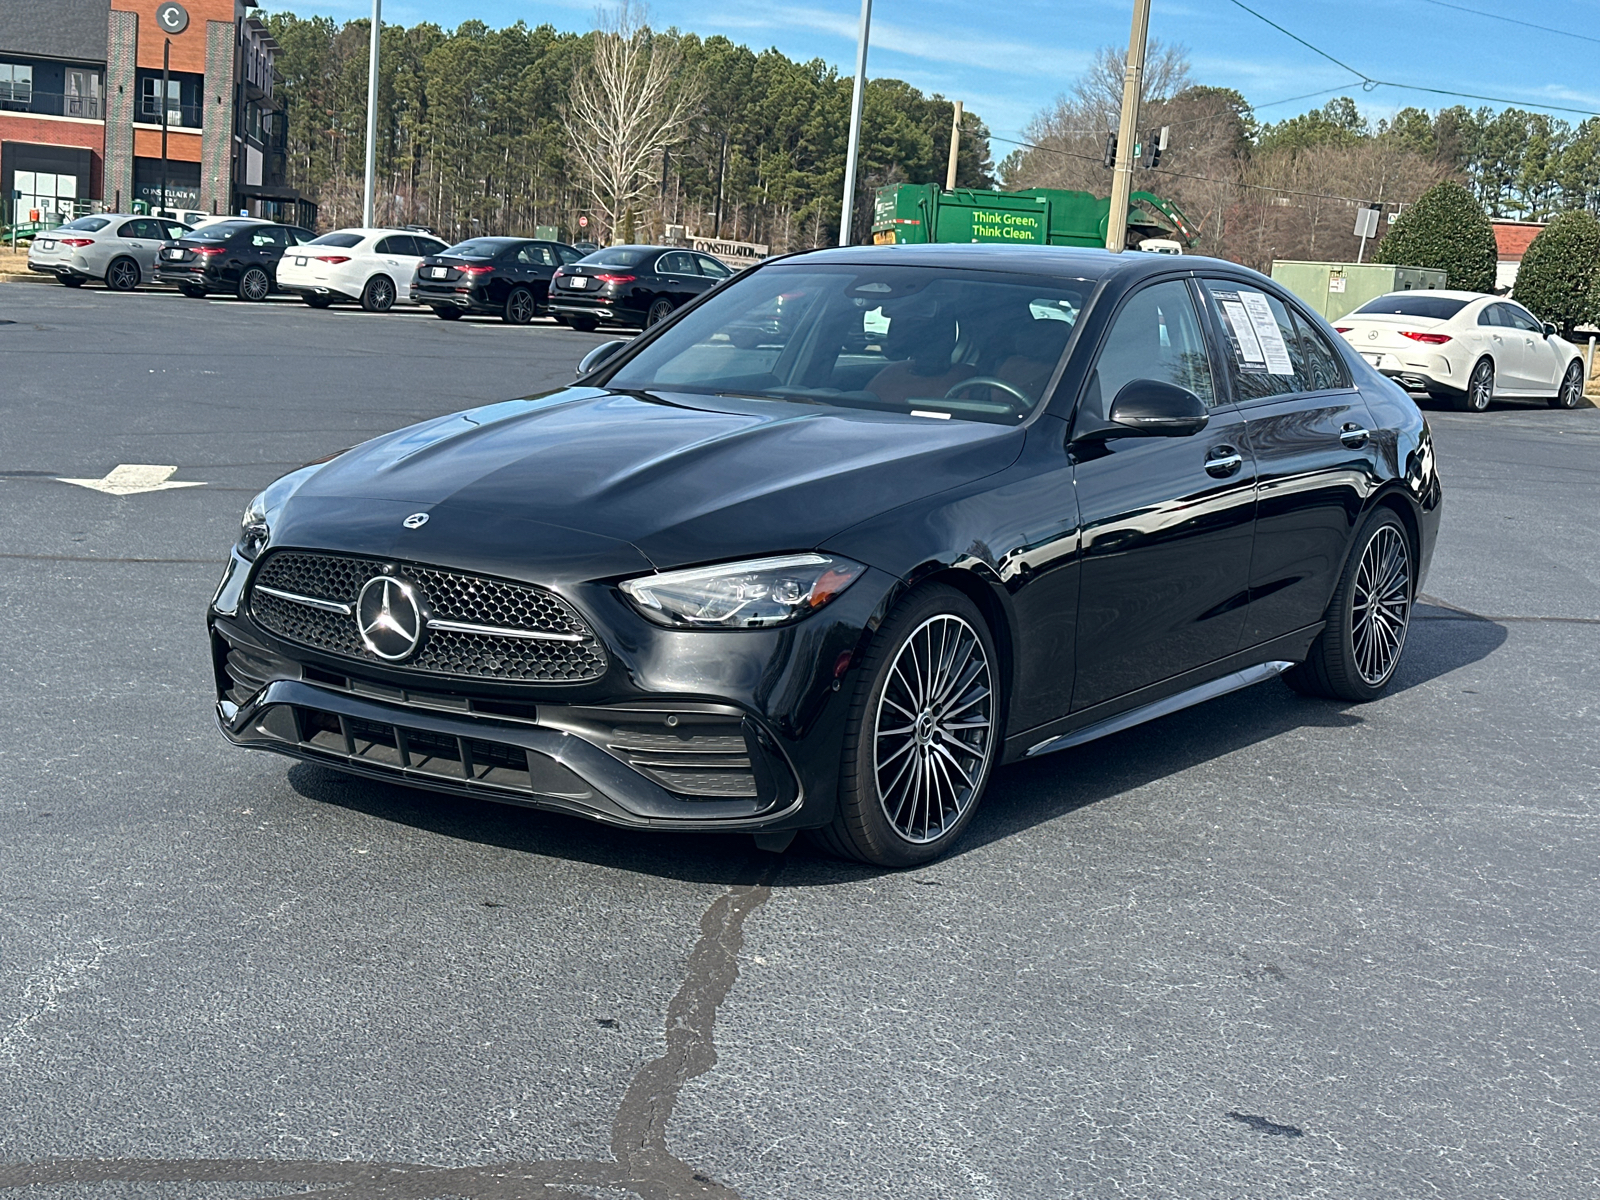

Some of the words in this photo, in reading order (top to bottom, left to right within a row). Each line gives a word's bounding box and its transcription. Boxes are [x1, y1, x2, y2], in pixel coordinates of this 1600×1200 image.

[142, 187, 196, 200] CONSELLATION
[972, 211, 1002, 224] Think
[1003, 213, 1038, 228] Green,
[972, 225, 1001, 238] Think
[1002, 226, 1035, 240] Clean.
[696, 241, 755, 258] CONSTELLATION
